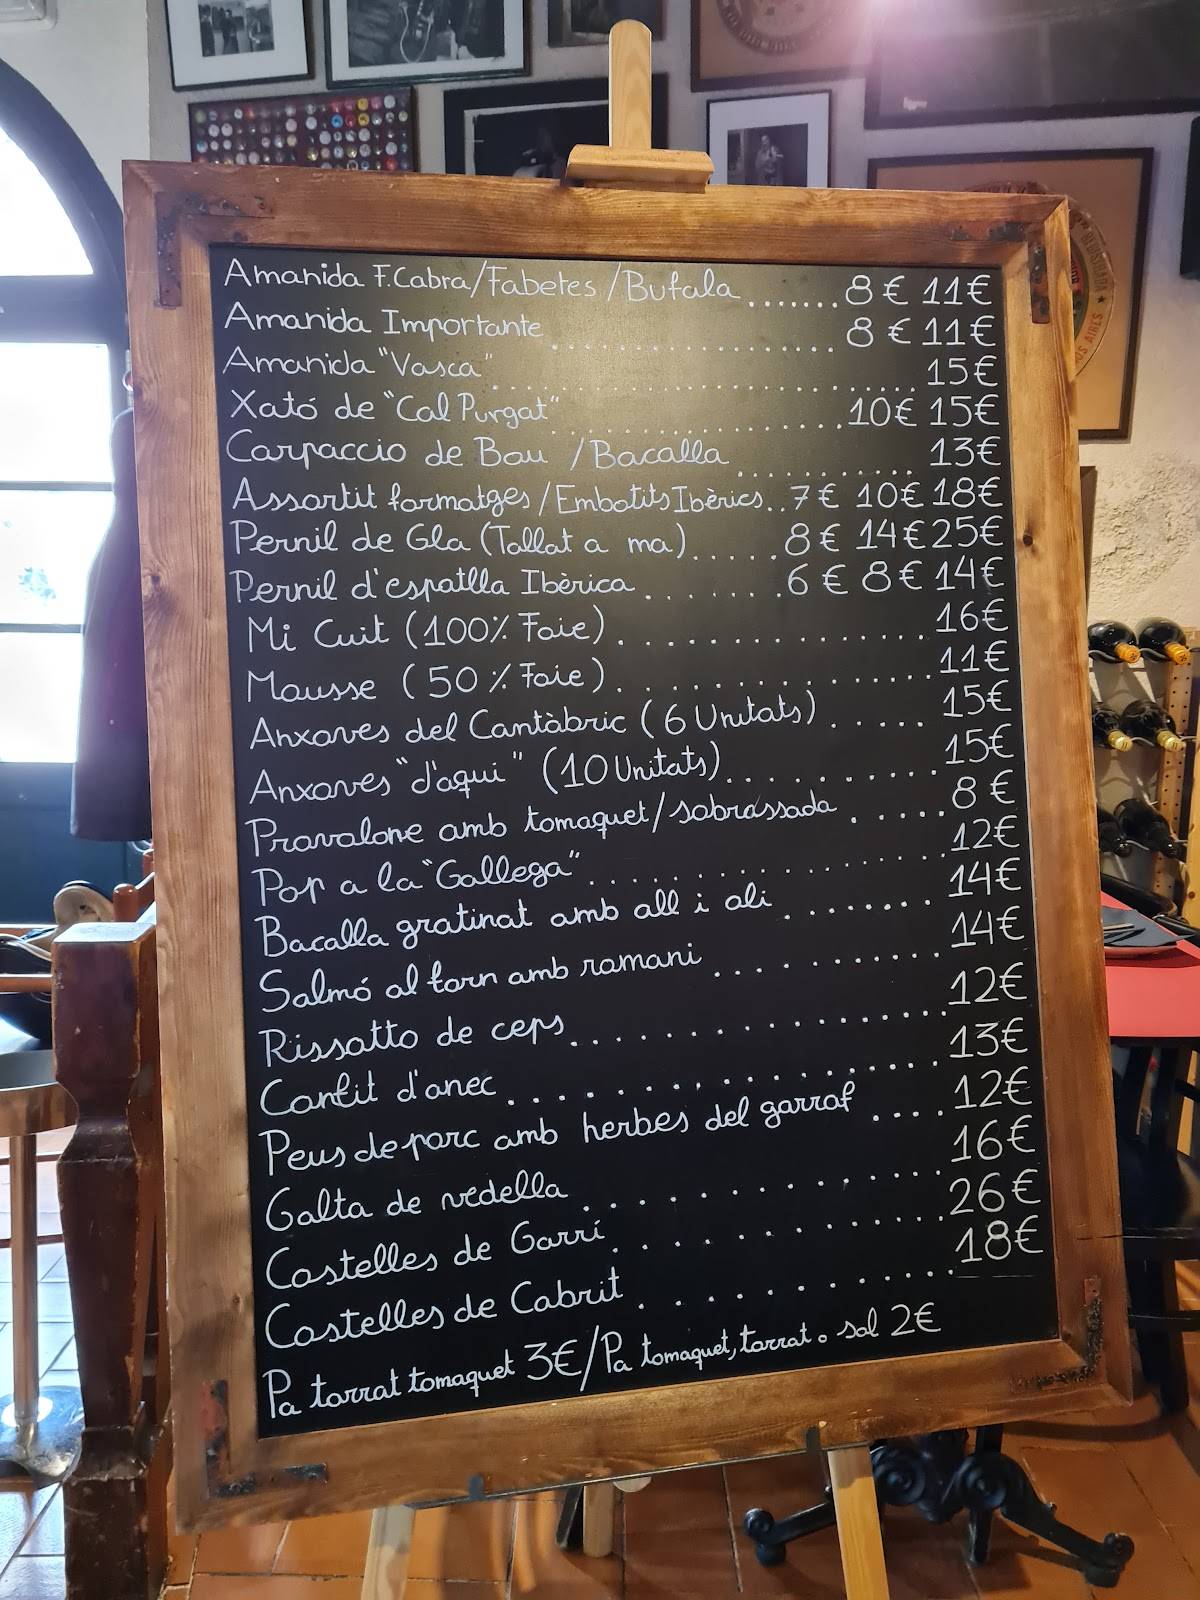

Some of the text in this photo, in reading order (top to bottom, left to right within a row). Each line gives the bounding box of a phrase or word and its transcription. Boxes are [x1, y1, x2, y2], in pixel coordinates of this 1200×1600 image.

[223, 257, 366, 288] Amanida
[922, 274, 993, 306] 11€
[223, 301, 373, 334] Amanida
[380, 308, 541, 343] Importante
[921, 314, 997, 347] 11€
[1087, 313, 1104, 344] AIRES
[222, 345, 376, 376] Amanida
[927, 354, 999, 388] 15€
[230, 389, 318, 421] Xató
[334, 391, 376, 420] de
[847, 396, 918, 427] 10€
[929, 393, 1000, 428] 15€
[225, 428, 407, 471] Carpaccio
[424, 439, 464, 467] de
[929, 435, 1002, 467] 13€
[232, 476, 378, 512] Assortit
[671, 485, 764, 513] Ibèrics
[855, 481, 925, 509] 10€
[932, 475, 1004, 509] 18€
[229, 519, 339, 555] Pernil
[351, 521, 395, 553] de
[405, 522, 472, 552] Gla
[480, 520, 574, 557] (Tallat
[583, 538, 609, 554] a
[855, 518, 927, 550] 14€
[931, 514, 1004, 549] 25€
[228, 569, 338, 604] Pernil
[520, 568, 636, 595] Ibèrica
[934, 554, 1005, 591] 14€
[248, 615, 297, 654] Mi
[313, 613, 390, 646] Cuit
[935, 597, 1009, 633] 16€
[939, 639, 1010, 674] 11€
[249, 716, 390, 750] Anxoves
[404, 711, 458, 744] del
[468, 705, 627, 740] Cantàbric
[942, 679, 1013, 718] 15€
[248, 768, 391, 805] Anxoves
[944, 722, 1015, 765] 15€
[438, 813, 508, 843] amb
[250, 867, 326, 907] Pop
[339, 879, 368, 896] a
[377, 860, 424, 893] la
[950, 814, 1021, 852] 12€
[253, 856, 1022, 958] Bacalla gratinat amb all i ali 14€
[258, 904, 1025, 1013] Salmó al forn amb romani 14€
[436, 1015, 473, 1047] de
[490, 1014, 565, 1046] ceps
[947, 961, 1028, 1006] 12€
[259, 1016, 1029, 1117] Confit d'anec 13€
[257, 1128, 347, 1177] Peus
[353, 1131, 399, 1163] de
[493, 1116, 559, 1151] amb
[582, 1106, 689, 1144] herbes
[704, 1095, 750, 1132] del
[759, 1080, 856, 1130] garraf
[953, 1065, 1033, 1110] 12€
[265, 1114, 1036, 1232] Galta de vedella 16€
[453, 1233, 493, 1266] de
[510, 1219, 606, 1255] Garrí
[949, 1168, 1042, 1216] 26€
[453, 1292, 498, 1323] de
[510, 1265, 624, 1315] Cabrit
[954, 1214, 1044, 1264] 18€
[261, 1368, 303, 1419] Pa
[308, 1367, 403, 1409] torrat
[407, 1348, 516, 1398] tomaquet
[836, 1306, 880, 1340] sal
[890, 1301, 942, 1337] 2€
